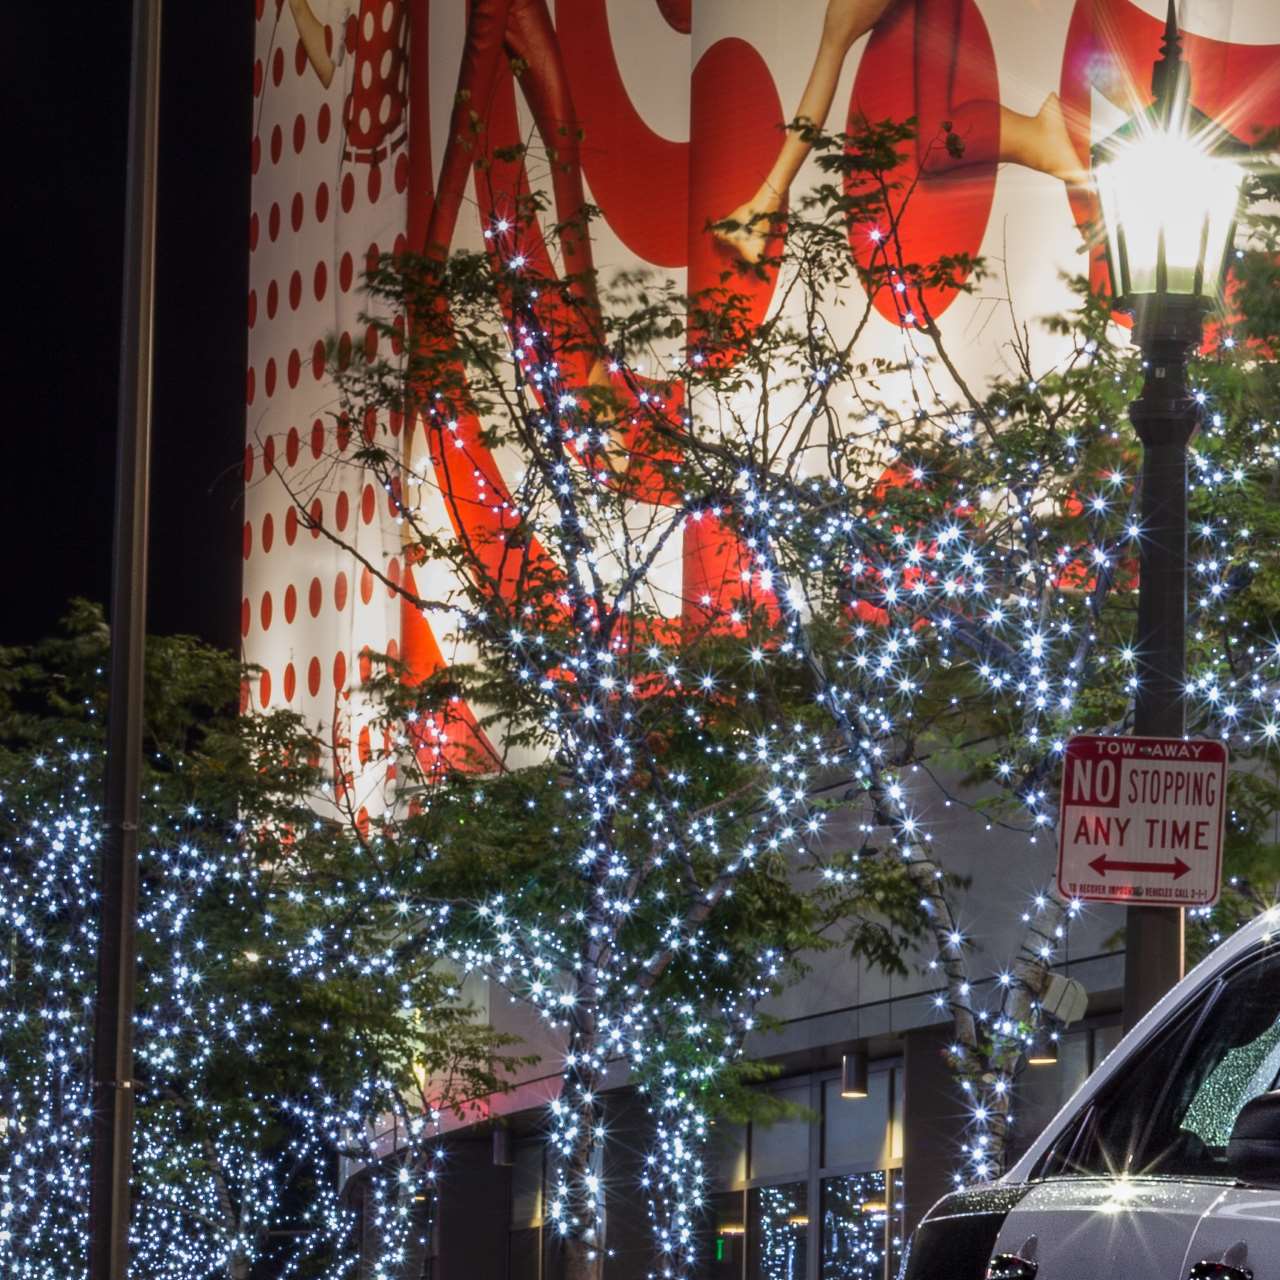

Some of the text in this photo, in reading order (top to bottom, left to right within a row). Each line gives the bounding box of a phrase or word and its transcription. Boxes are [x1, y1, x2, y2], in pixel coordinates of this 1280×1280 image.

[1072, 758, 1217, 807] NO STOPPING
[1073, 815, 1210, 851] ANY TIME
[1175, 888, 1189, 898] CALL
